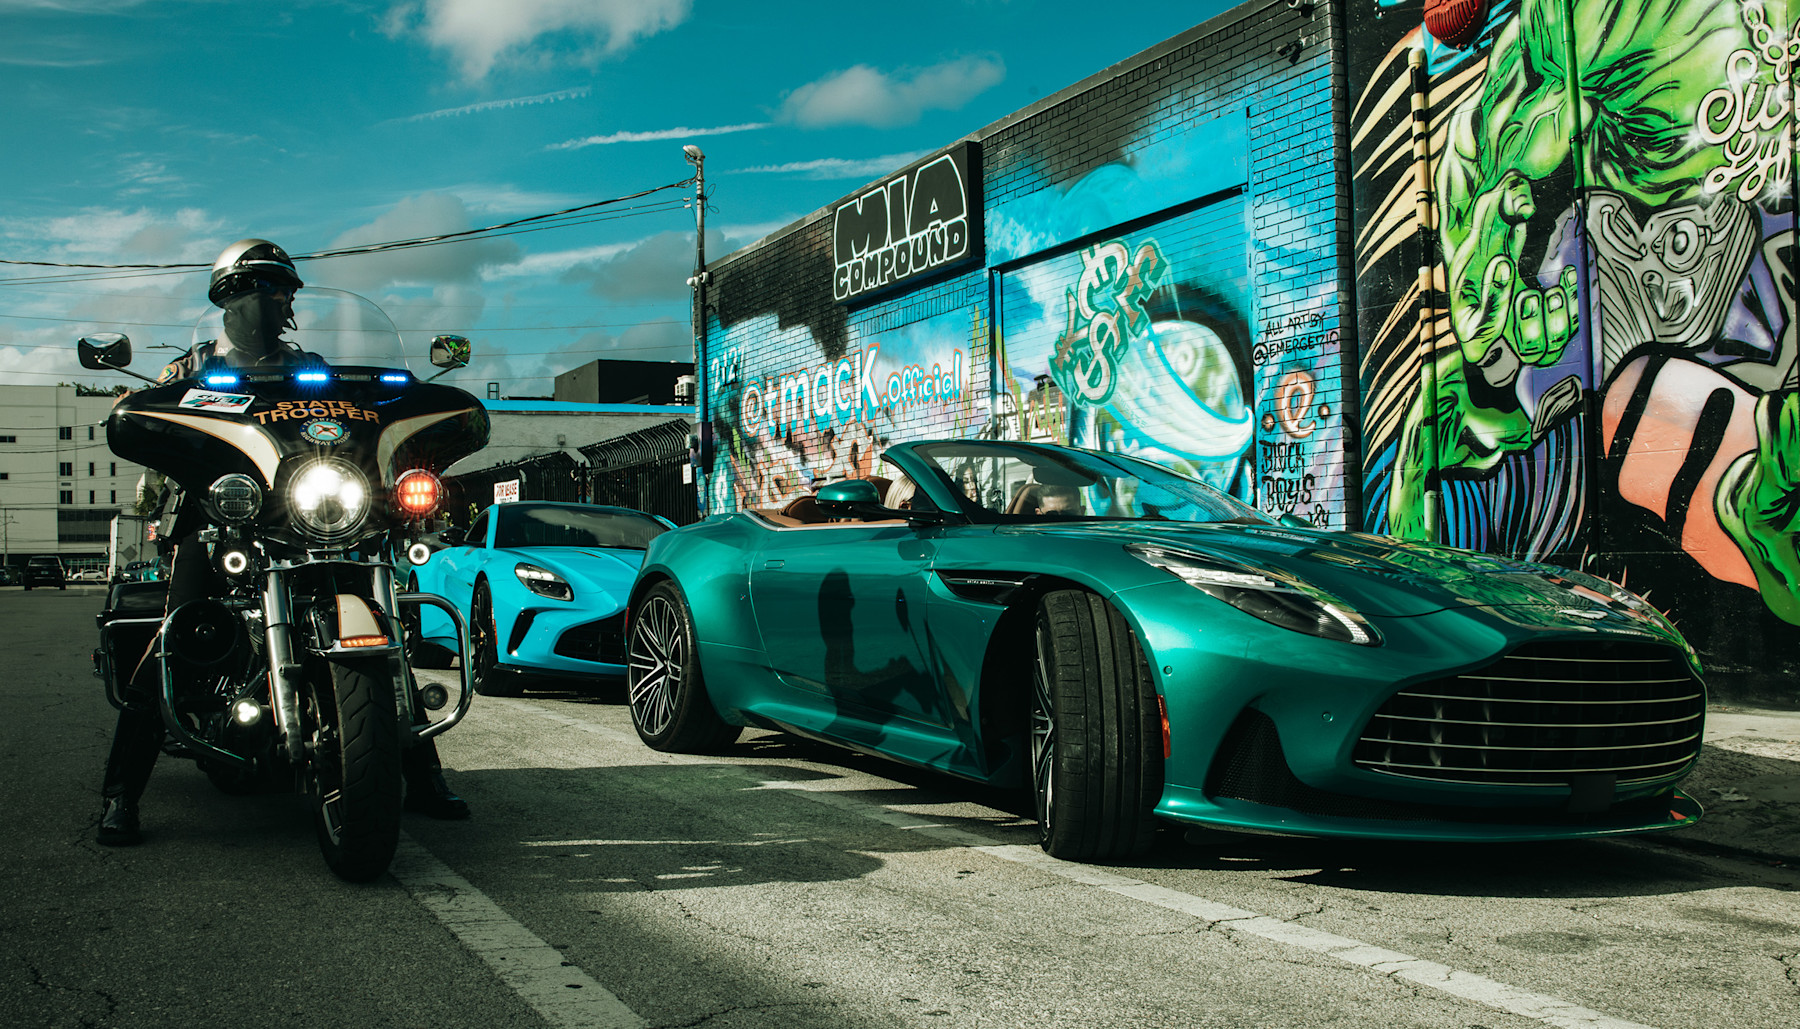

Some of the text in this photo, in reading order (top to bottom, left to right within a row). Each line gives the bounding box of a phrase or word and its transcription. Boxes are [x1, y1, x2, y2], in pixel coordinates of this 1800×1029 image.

[834, 153, 967, 268] MIA
[834, 218, 968, 300] COMPOUND
[1265, 311, 1326, 339] ALL ART BY
[252, 407, 380, 425] TROOPER
[276, 400, 356, 411] STATE
[302, 417, 343, 427] FLORIDA
